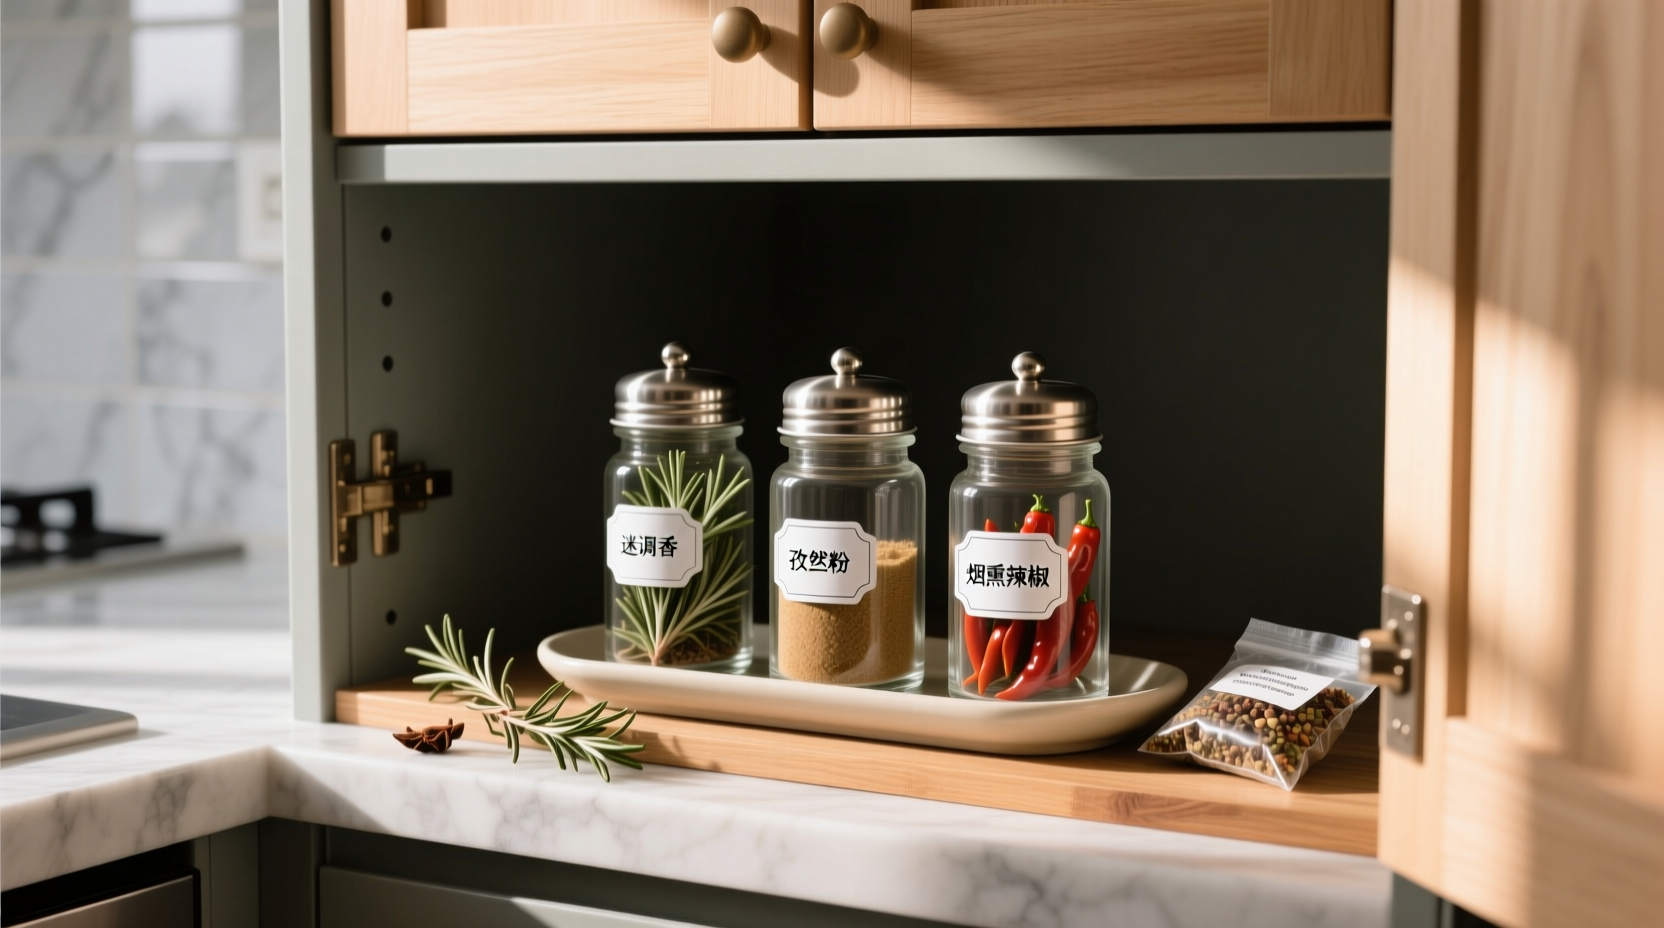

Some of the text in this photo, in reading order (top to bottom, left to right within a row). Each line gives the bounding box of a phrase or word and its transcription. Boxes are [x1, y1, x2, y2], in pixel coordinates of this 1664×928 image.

[789, 548, 851, 574] 孜然粉
[966, 562, 1050, 588] 烟熏辣椒
